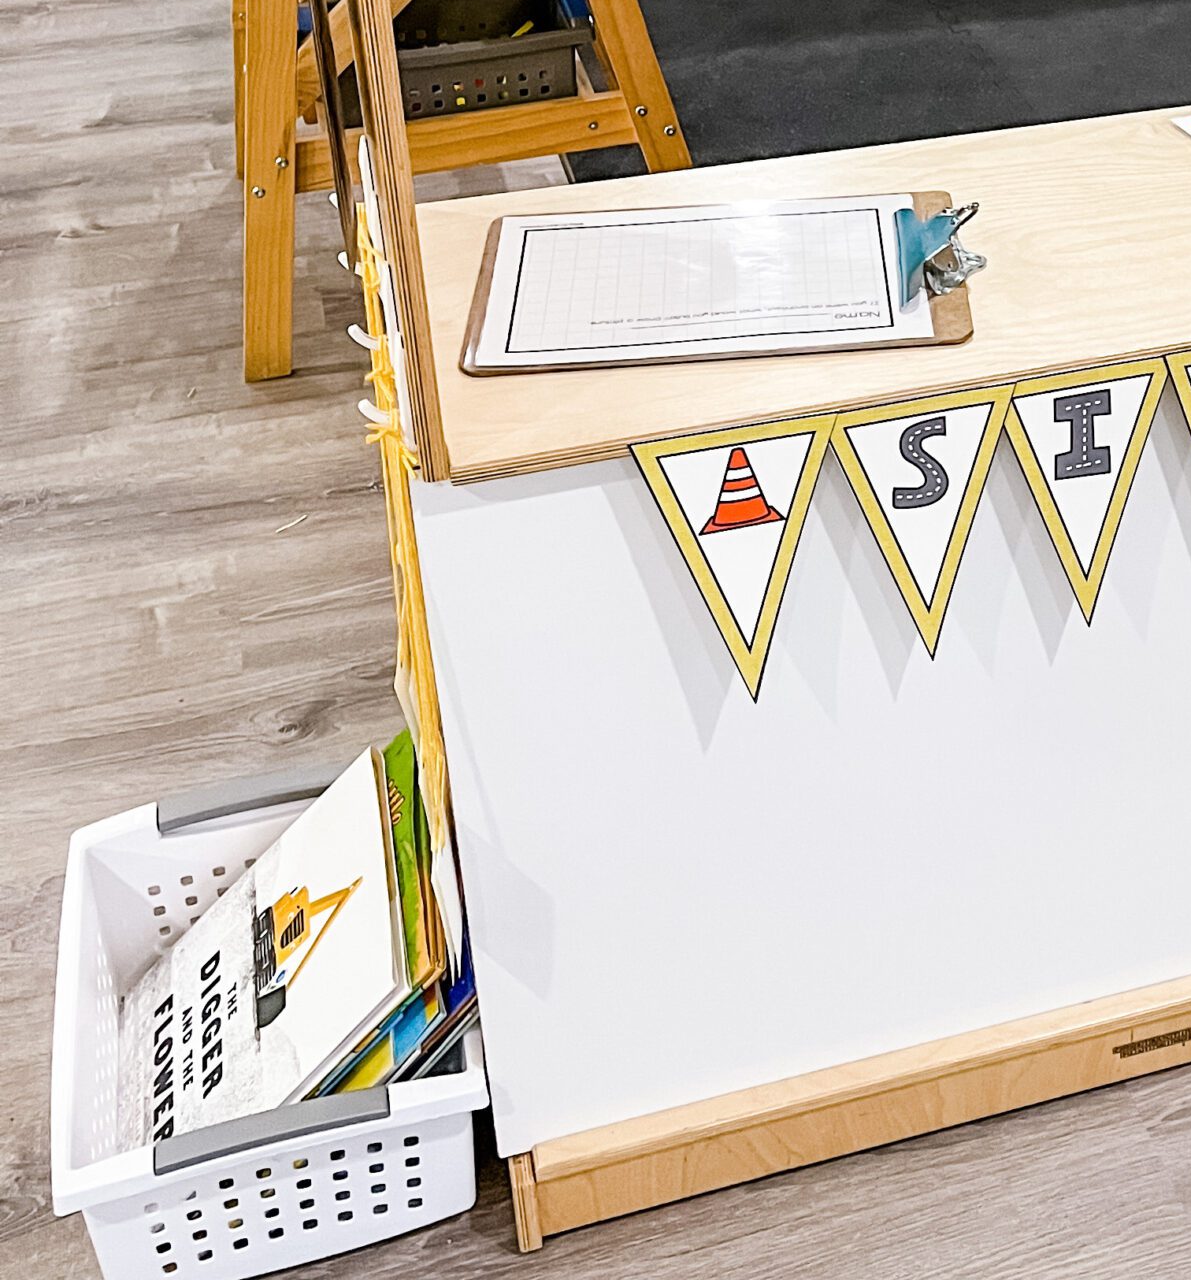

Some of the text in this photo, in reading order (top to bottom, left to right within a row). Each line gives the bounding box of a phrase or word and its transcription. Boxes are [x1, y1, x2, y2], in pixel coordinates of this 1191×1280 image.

[834, 311, 881, 319] Name
[200, 950, 223, 1099] DIGGER
[227, 981, 238, 1020] THE
[153, 993, 174, 1142] FLOWER
[182, 1006, 194, 1091] AND THE
